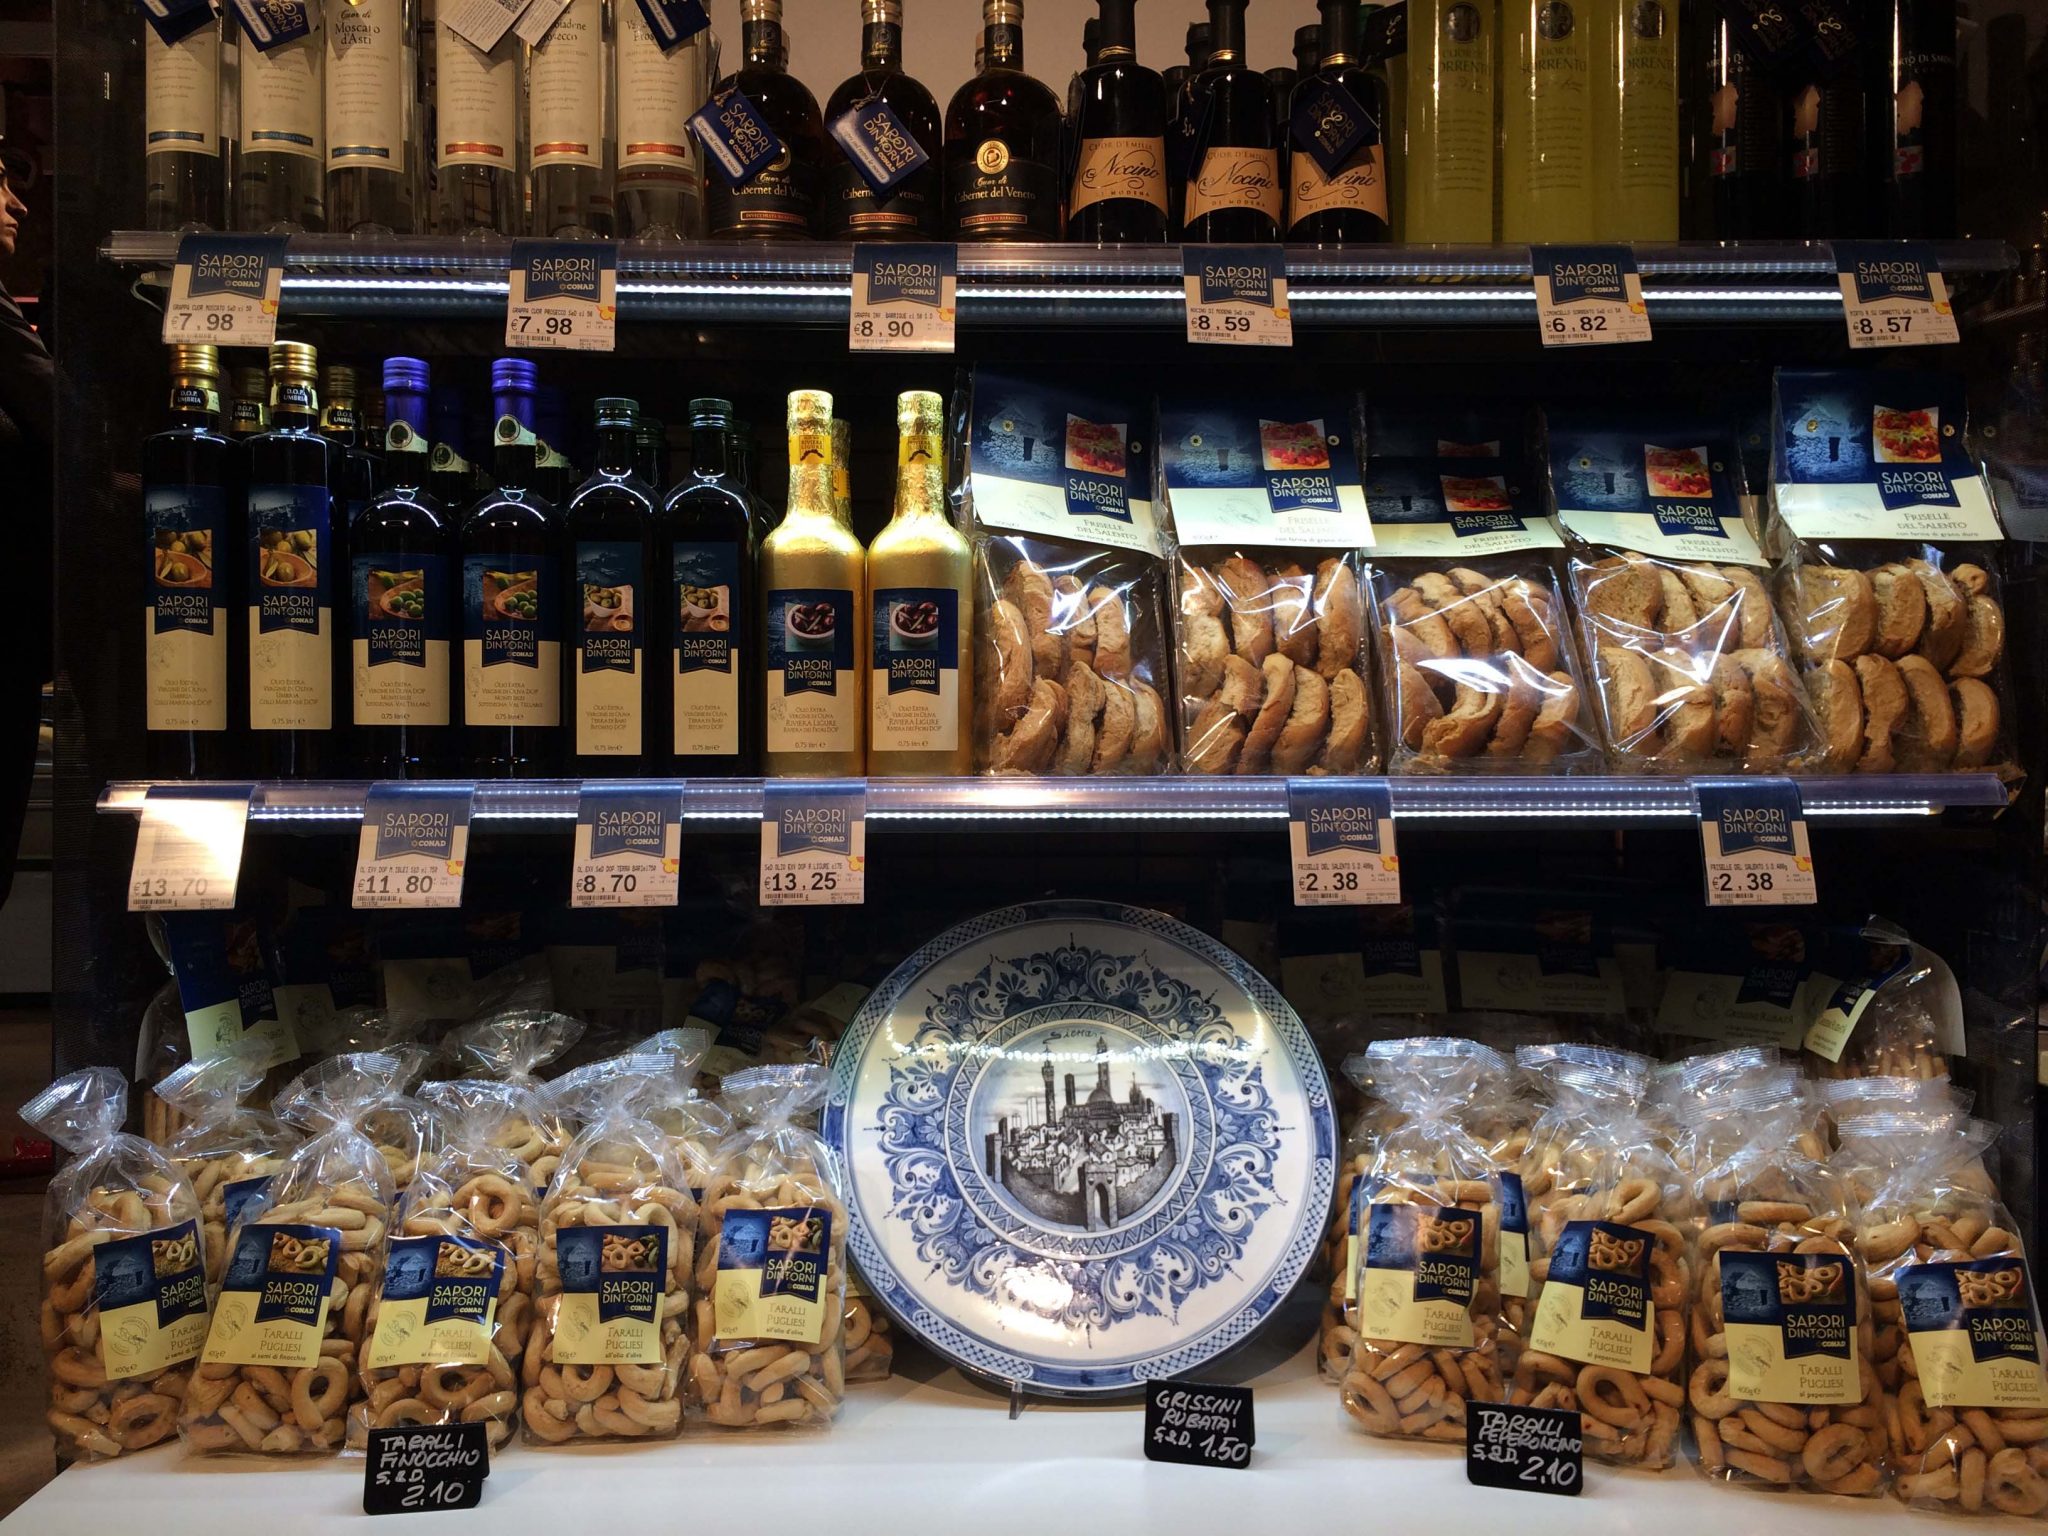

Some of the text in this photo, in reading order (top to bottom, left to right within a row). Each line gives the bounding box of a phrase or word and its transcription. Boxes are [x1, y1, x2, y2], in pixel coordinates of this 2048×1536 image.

[341, 32, 372, 45] d'Asti
[728, 103, 773, 155] SAPORI
[719, 110, 761, 162] DINTORNI
[873, 111, 918, 163] SAPORI
[863, 119, 907, 170] DINTORNI
[1100, 151, 1161, 179] Nocino
[1222, 160, 1274, 190] Nocino
[990, 185, 1004, 198] del
[1005, 187, 1036, 201] Veneto
[199, 253, 265, 269] SAPORI
[531, 258, 595, 272] SAPORI
[1858, 261, 1921, 274] SAPORI
[197, 267, 263, 280] DINTORNI
[874, 262, 937, 277] SAPORI
[1205, 265, 1267, 280] SAPORI
[1554, 263, 1618, 277] SAPORI
[531, 271, 595, 282] DINTORNI
[874, 275, 937, 288] DINTORNI
[1556, 275, 1619, 287] DINTORNI
[1860, 273, 1923, 285] DINTORNI
[1206, 278, 1267, 289] DINTORNI
[177, 396, 202, 404] UMBRIA
[283, 394, 308, 402] UMBRIA
[1270, 476, 1330, 489] SAPORI
[1881, 471, 1944, 484] SAPORI
[1069, 478, 1123, 498] SAPORI
[1272, 488, 1332, 498] DINTORNI
[1884, 482, 1948, 494] DINTORNI
[1070, 490, 1124, 508] DINTORNI
[1656, 504, 1713, 518] SAPORI
[1904, 512, 1951, 521] FRISELLE
[1454, 513, 1517, 524] SAPORI
[1660, 515, 1717, 526] DINTORNI
[1897, 522, 1968, 530] DEL SALENTO
[158, 595, 208, 608] SAPORI
[263, 595, 314, 608] SAPORI
[158, 607, 208, 617] DINTORNI
[263, 607, 314, 617] DINTORNI
[371, 628, 421, 641] SAPORI
[485, 629, 534, 641] SAPORI
[371, 640, 421, 649] DINTORNI
[485, 640, 534, 650] DINTORNI
[586, 638, 631, 650] SAPORI
[683, 639, 727, 650] SAPORI
[586, 649, 631, 658] DINTORNI
[683, 649, 727, 658] DINTORNI
[787, 659, 832, 671] SAPORI
[891, 658, 936, 669] SAPORI
[787, 670, 832, 680] DINTORNI
[891, 669, 936, 679] DINTORNI
[385, 813, 449, 827] SAPORI
[598, 811, 661, 825] SAPORI
[784, 808, 846, 823] SAPORI
[1310, 807, 1372, 822] SAPORI
[1722, 808, 1785, 822] SAPORI
[384, 827, 448, 838] DINTORNI
[598, 825, 660, 836] DINTORNI
[784, 823, 846, 834] DINTORNI
[1311, 821, 1373, 833] DINTORNI
[1724, 822, 1787, 834] DINTORNI
[767, 1258, 817, 1274] SAPORI
[1418, 1261, 1471, 1278] SAPORI
[766, 1270, 816, 1284] DINTORNI
[1418, 1274, 1470, 1288] DINTORNI
[160, 1274, 202, 1299] SAPORI
[266, 1281, 319, 1296] SAPORI
[433, 1286, 487, 1297] SAPORI
[602, 1281, 654, 1293] SAPORI
[1588, 1278, 1643, 1300] SAPORI
[264, 1294, 316, 1306] DINTORNI
[432, 1296, 485, 1307] DINTORNI
[602, 1293, 653, 1304] DINTORNI
[1587, 1291, 1643, 1311] DINTORNI
[769, 1303, 806, 1316] TARALLI
[1424, 1307, 1464, 1322] TARALLI
[766, 1315, 806, 1327] PUGLIESI
[1786, 1314, 1845, 1328] SAPORI
[1971, 1318, 2031, 1332] SAPORI
[263, 1327, 304, 1340] TARALLI
[608, 1327, 643, 1337] TARALLI
[1591, 1326, 1633, 1344] TARALLI
[1787, 1328, 1846, 1339] DINTORNI
[1974, 1331, 2033, 1342] DINTORNI
[260, 1340, 302, 1352] PUGLIESI
[605, 1340, 643, 1349] PUGLIESI
[1588, 1338, 1632, 1356] PUGLIESI
[1798, 1363, 1843, 1375] TARALLI
[1989, 1367, 2036, 1379] TARALLI
[1800, 1377, 1844, 1389] PUGLIESI
[1992, 1381, 2038, 1393] PUGLIESI
[1156, 1390, 1242, 1415] GRISSINI
[1477, 1410, 1564, 1438] TARALLI
[379, 1433, 464, 1452] TARALLI
[1478, 1425, 1583, 1453] PEPERONCINO
[1199, 1434, 1248, 1462] 1.50
[379, 1449, 481, 1469] FINOCCHIO
